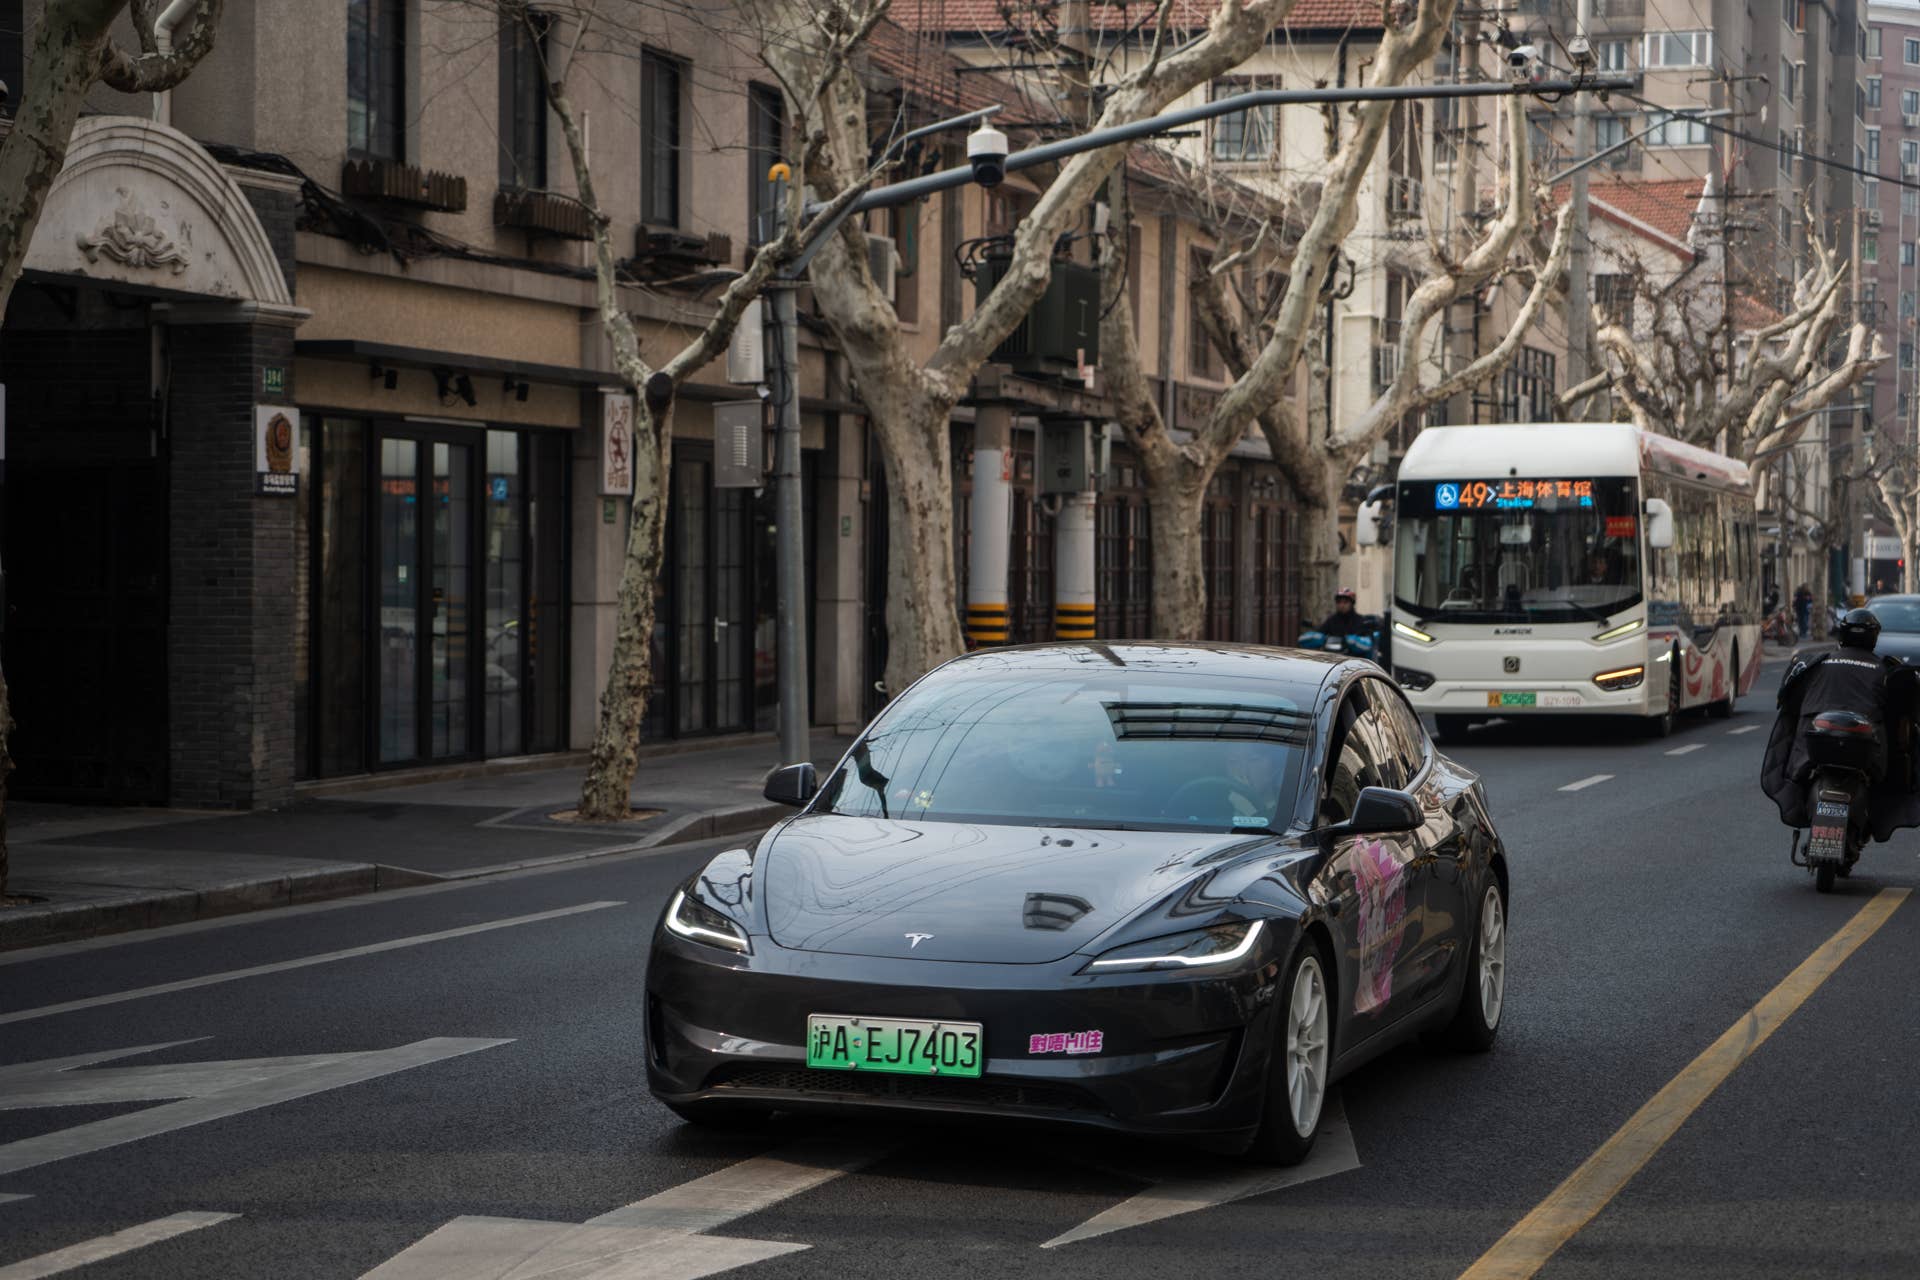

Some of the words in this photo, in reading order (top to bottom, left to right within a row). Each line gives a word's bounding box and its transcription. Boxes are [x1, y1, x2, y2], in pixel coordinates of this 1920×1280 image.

[266, 369, 282, 385] 394
[1459, 482, 1487, 508] 49
[1498, 480, 1592, 498] 上海体育馆
